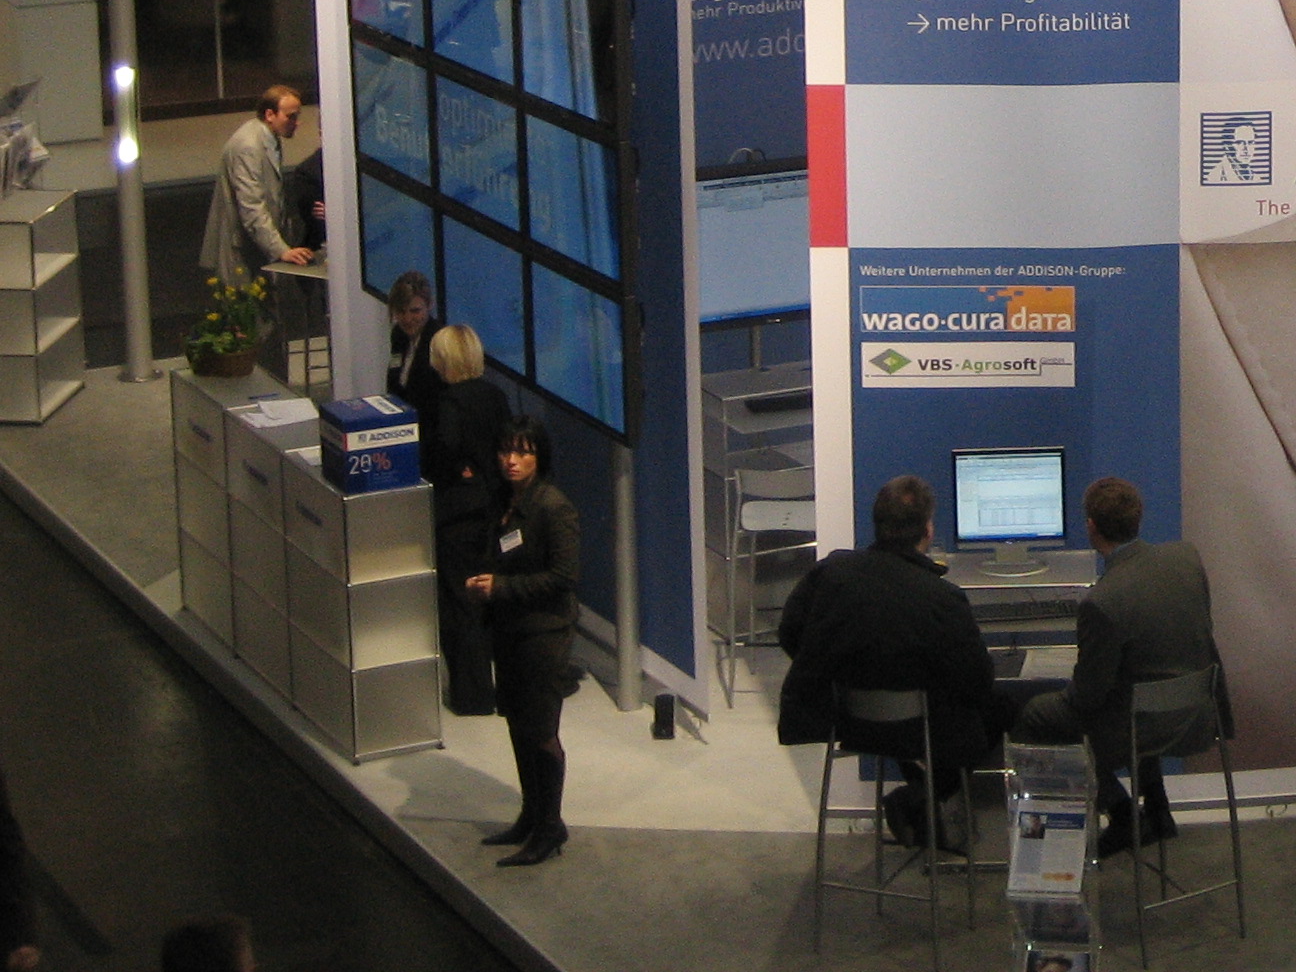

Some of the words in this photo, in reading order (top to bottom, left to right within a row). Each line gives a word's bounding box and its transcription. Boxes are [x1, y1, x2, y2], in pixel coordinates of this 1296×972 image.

[936, 13, 995, 32] mehr
[1001, 12, 1131, 32] Profitabilität
[1255, 199, 1291, 216] The
[859, 265, 906, 277] Weitere
[909, 265, 992, 277] Unternehmen
[994, 265, 1014, 277] der
[1016, 264, 1127, 279] ADDISON-Gruppe:
[918, 358, 953, 371] VBS
[962, 357, 1038, 374] Agrosoft
